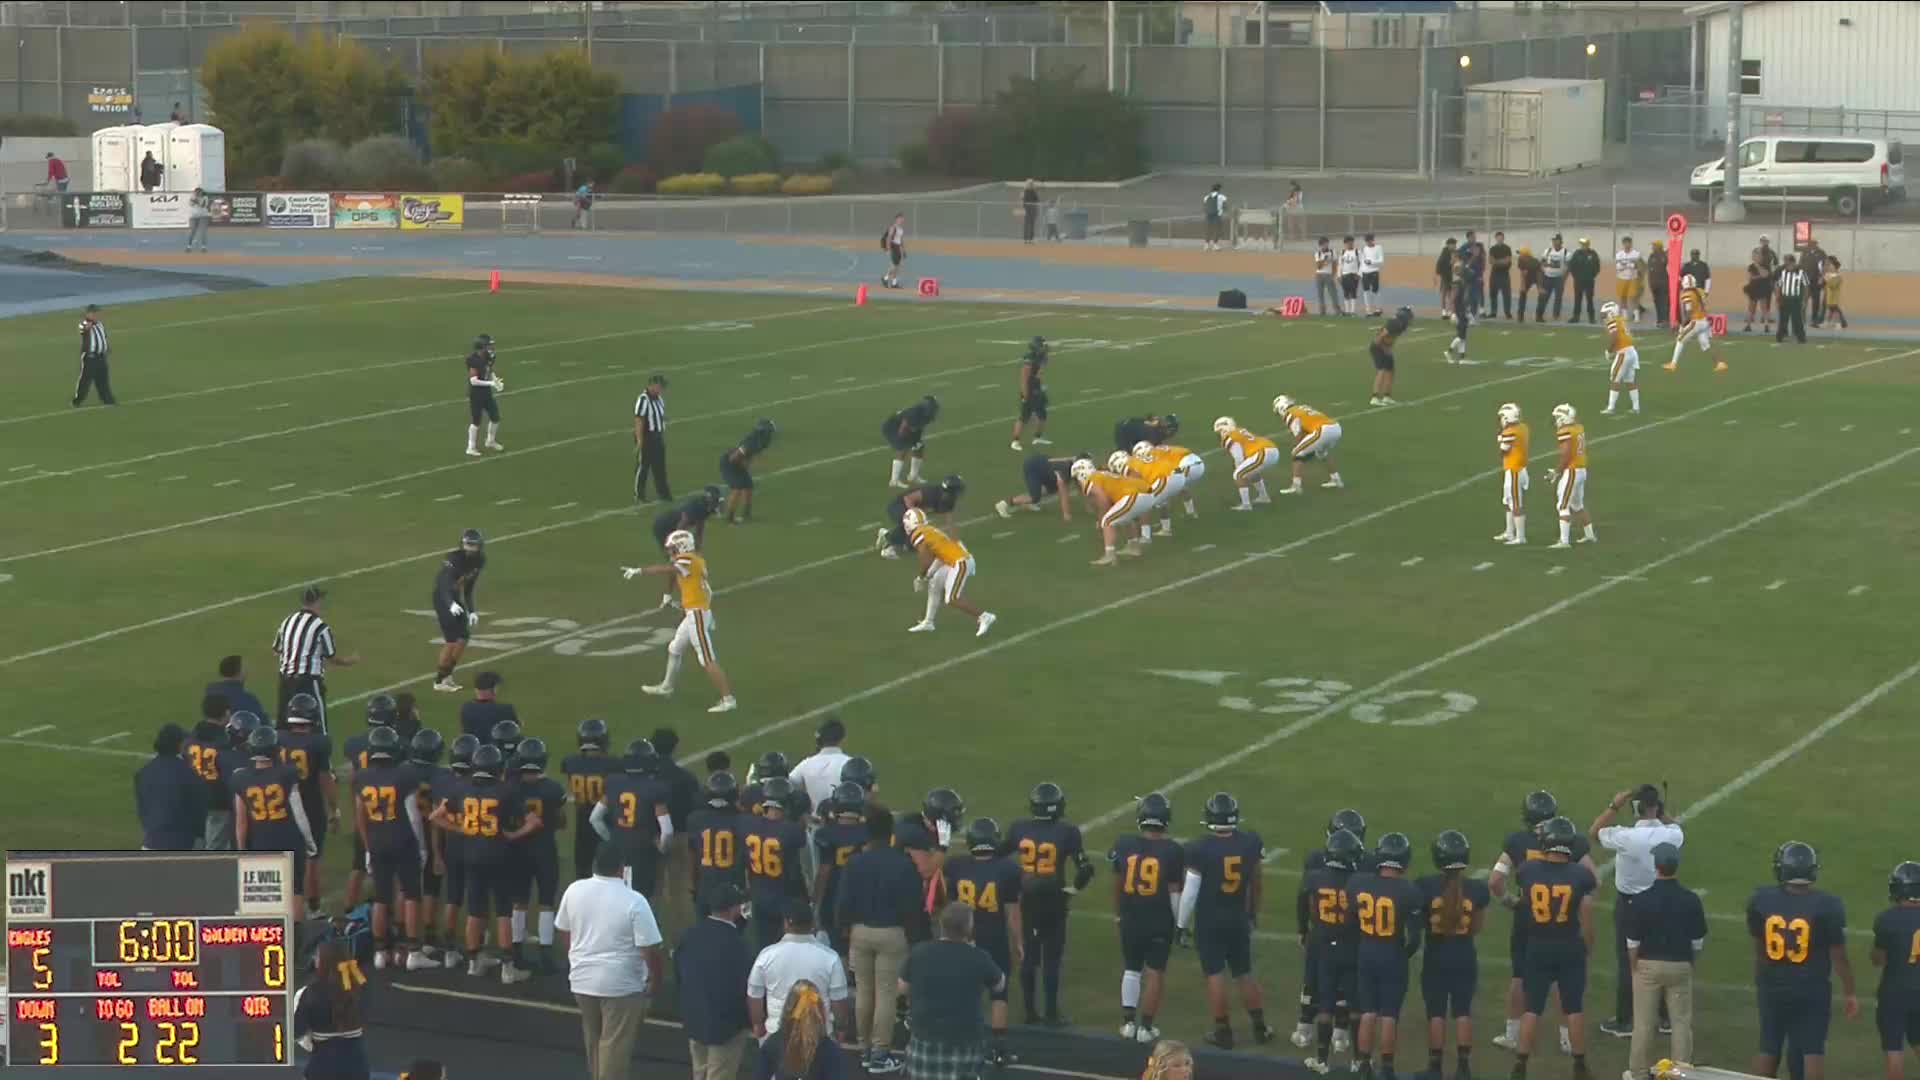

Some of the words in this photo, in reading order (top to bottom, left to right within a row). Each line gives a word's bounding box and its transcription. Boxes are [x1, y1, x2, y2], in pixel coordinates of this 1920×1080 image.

[92, 104, 128, 113] NATION
[920, 281, 935, 296] G
[1283, 297, 1300, 315] 10
[246, 783, 287, 821] 32
[362, 786, 396, 822] 27
[463, 797, 498, 837] 85
[617, 791, 637, 828] 3
[701, 828, 734, 868] 10
[1018, 838, 1056, 875] 22
[1124, 855, 1159, 896] 19
[1221, 855, 1241, 893] 5
[956, 879, 998, 912] 84
[1357, 892, 1395, 937] 20
[1530, 883, 1572, 923] 87
[1765, 914, 1810, 963] 63
